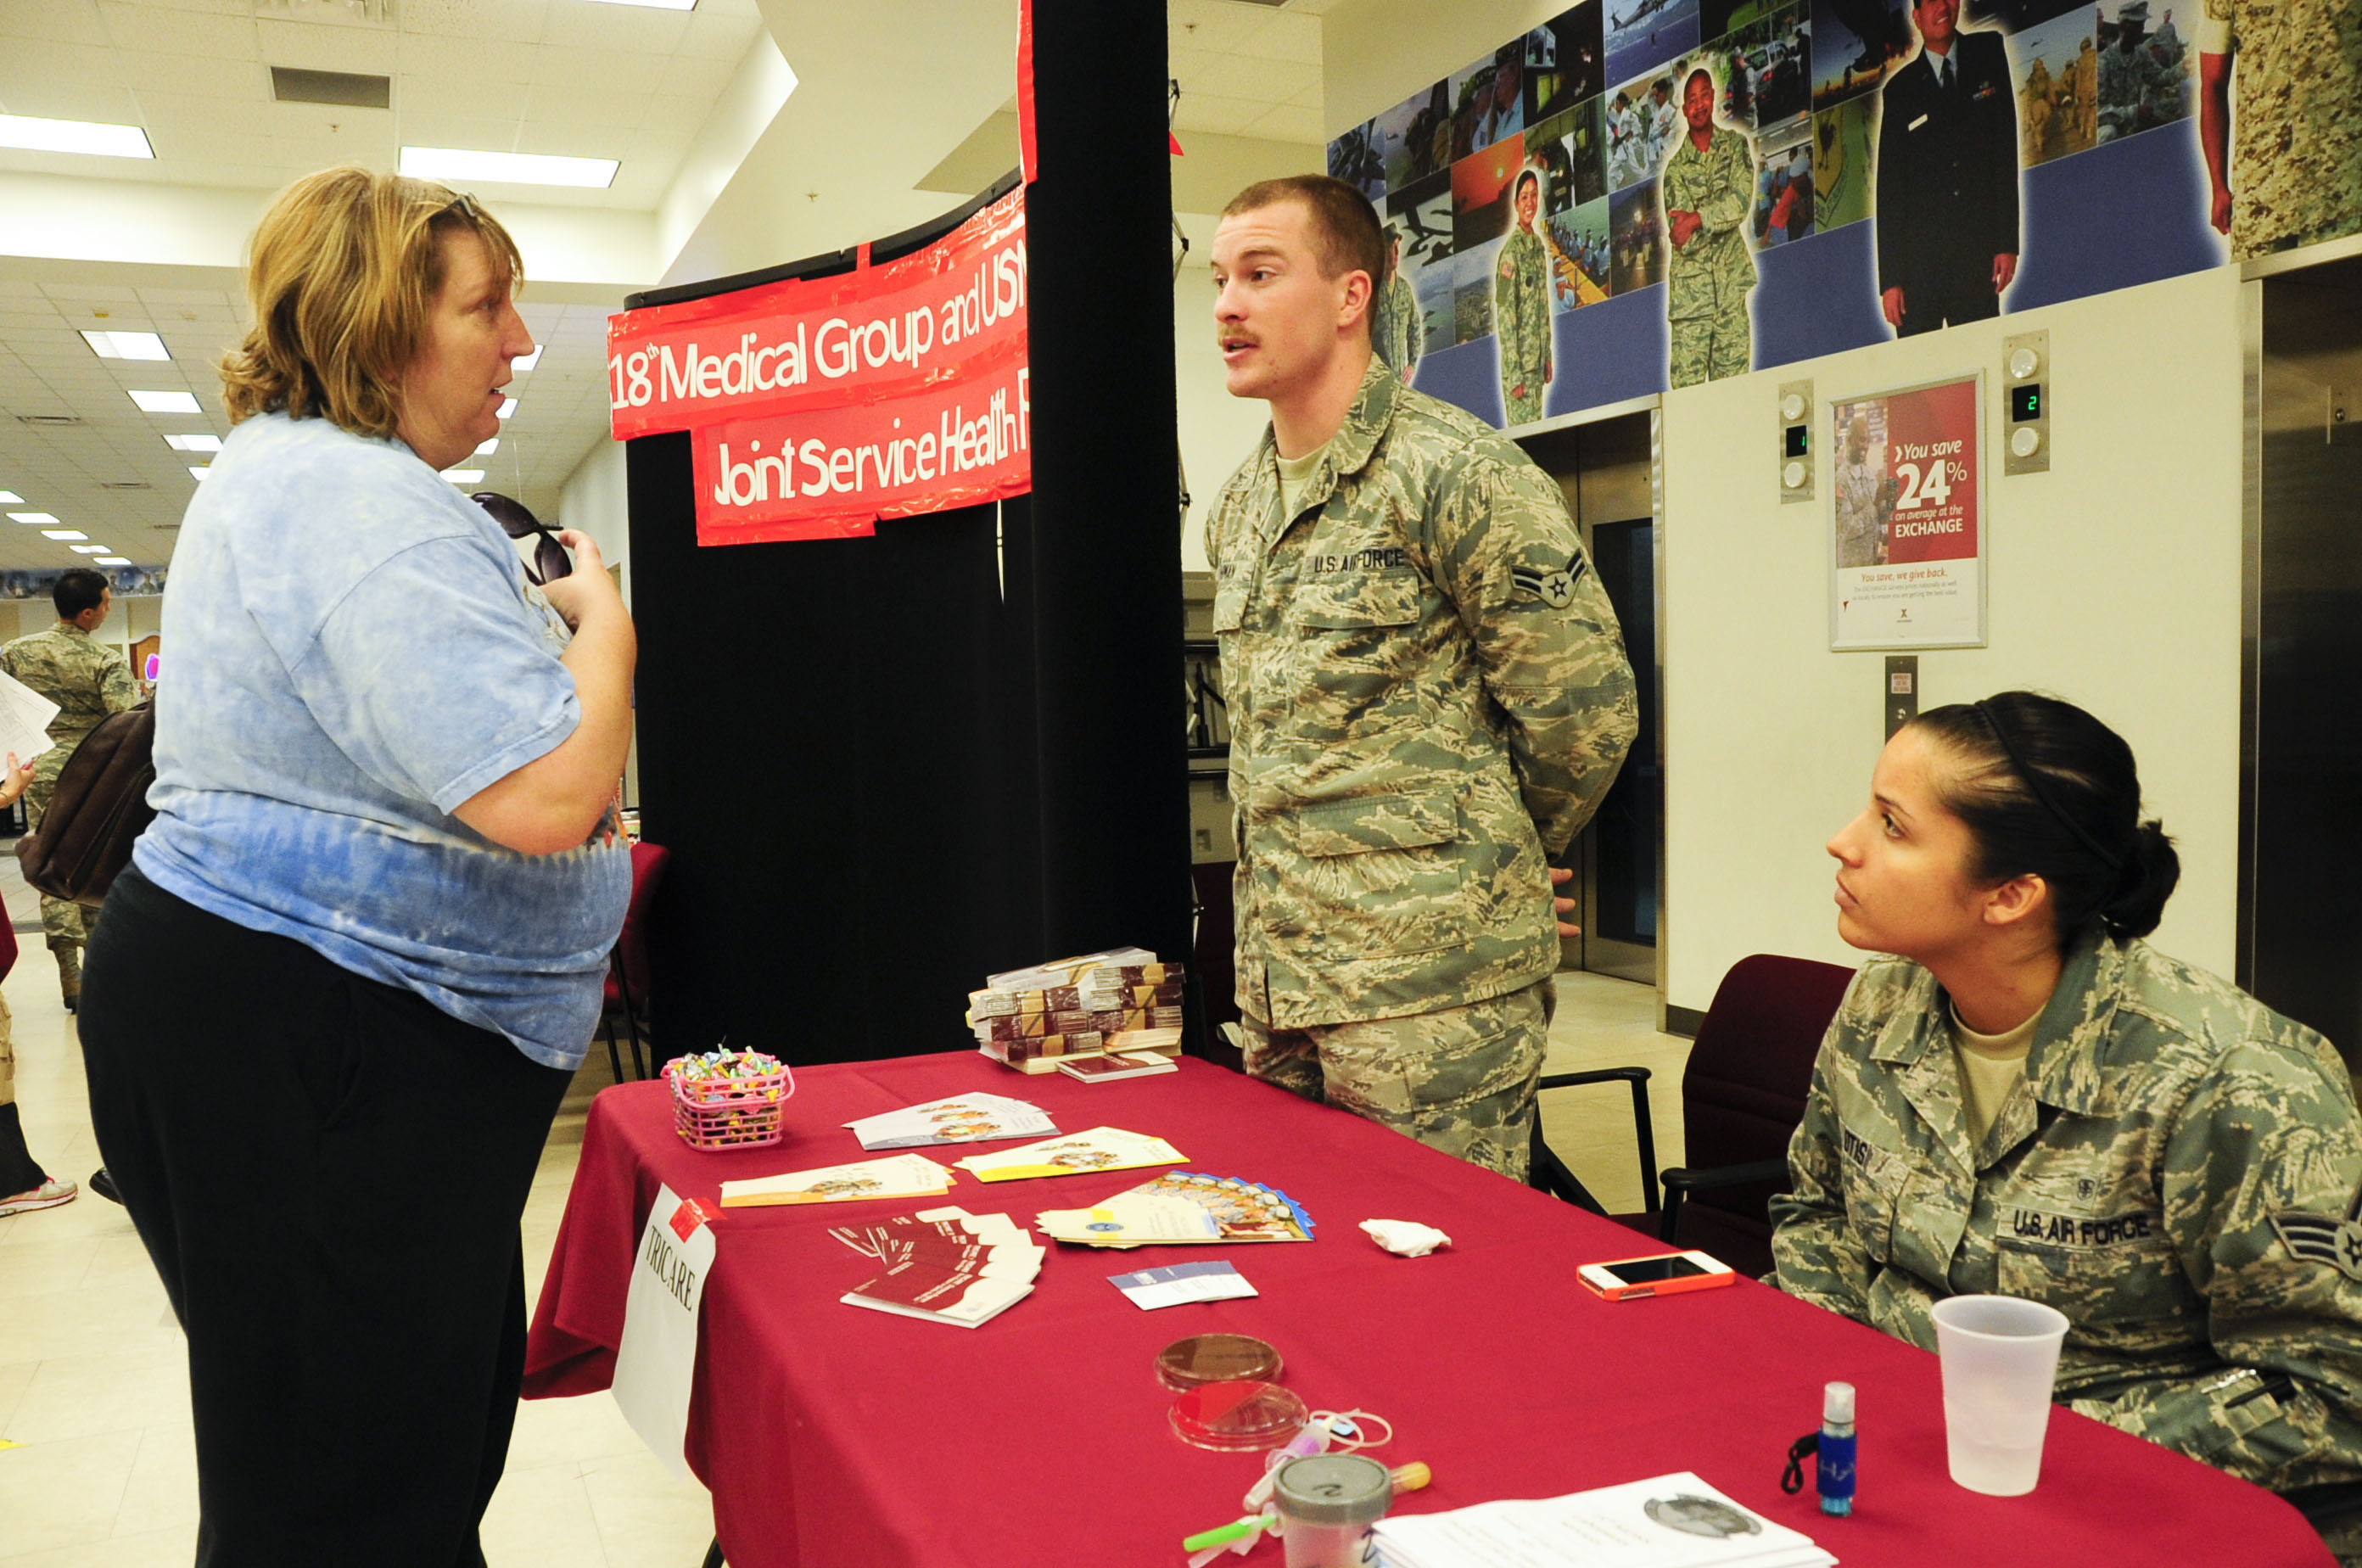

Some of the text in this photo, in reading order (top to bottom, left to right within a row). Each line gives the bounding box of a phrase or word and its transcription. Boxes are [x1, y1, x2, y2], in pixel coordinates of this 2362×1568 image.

[661, 322, 808, 402] Medical
[814, 306, 933, 378] Group
[941, 272, 979, 345] and
[2028, 395, 2036, 411] 2
[714, 438, 796, 507] Joint
[799, 417, 936, 496] Service
[940, 387, 1018, 476] Health
[1904, 440, 1962, 460] You save
[1896, 459, 1967, 510] 24%
[1896, 504, 1963, 521] on average at the
[1896, 518, 1963, 538] EXCHANGE
[1315, 556, 1337, 573] U.S.
[1357, 549, 1405, 568] FORCE
[1861, 573, 1875, 582] You
[1877, 573, 1895, 581] save,
[1909, 569, 1926, 581] give
[1927, 567, 1948, 578] back.
[2013, 1209, 2152, 1246] U.S. AIR FORCE
[646, 1224, 696, 1312] TRICARE
